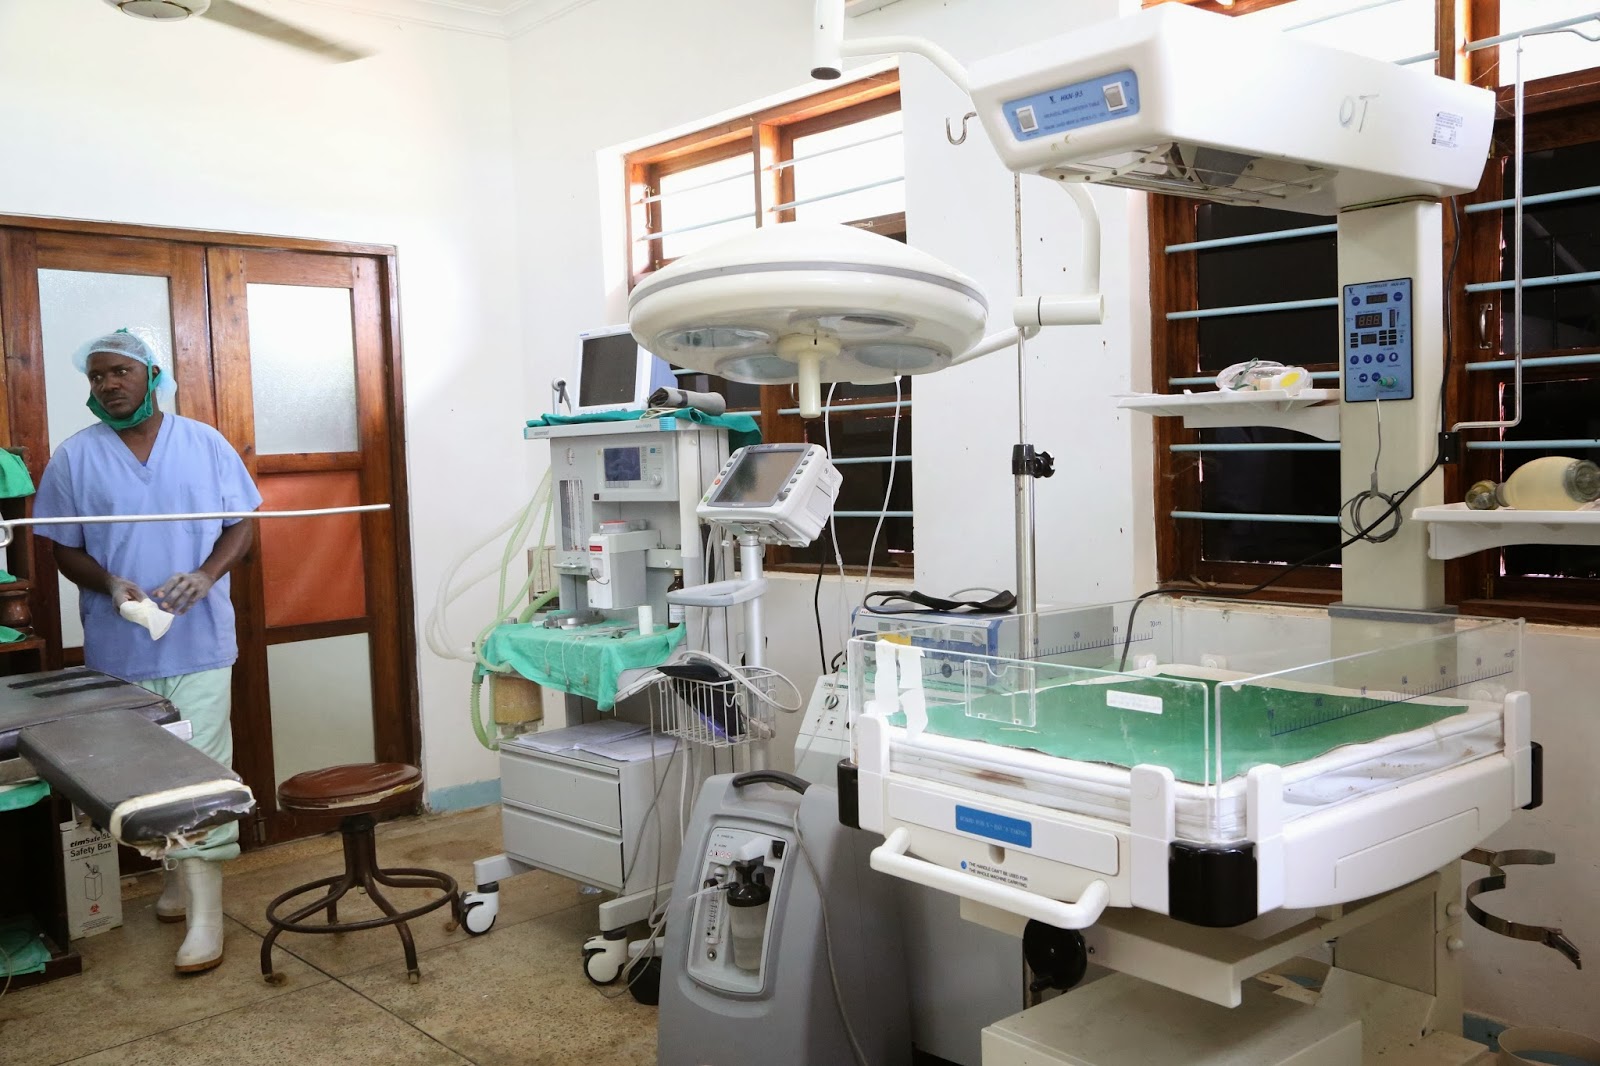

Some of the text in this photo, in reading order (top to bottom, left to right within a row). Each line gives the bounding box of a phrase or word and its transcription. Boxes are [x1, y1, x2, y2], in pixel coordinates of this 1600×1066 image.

[1339, 94, 1379, 133] OT
[70, 846, 95, 857] Safety
[97, 842, 111, 850] Box
[990, 873, 1007, 882] MACHINE
